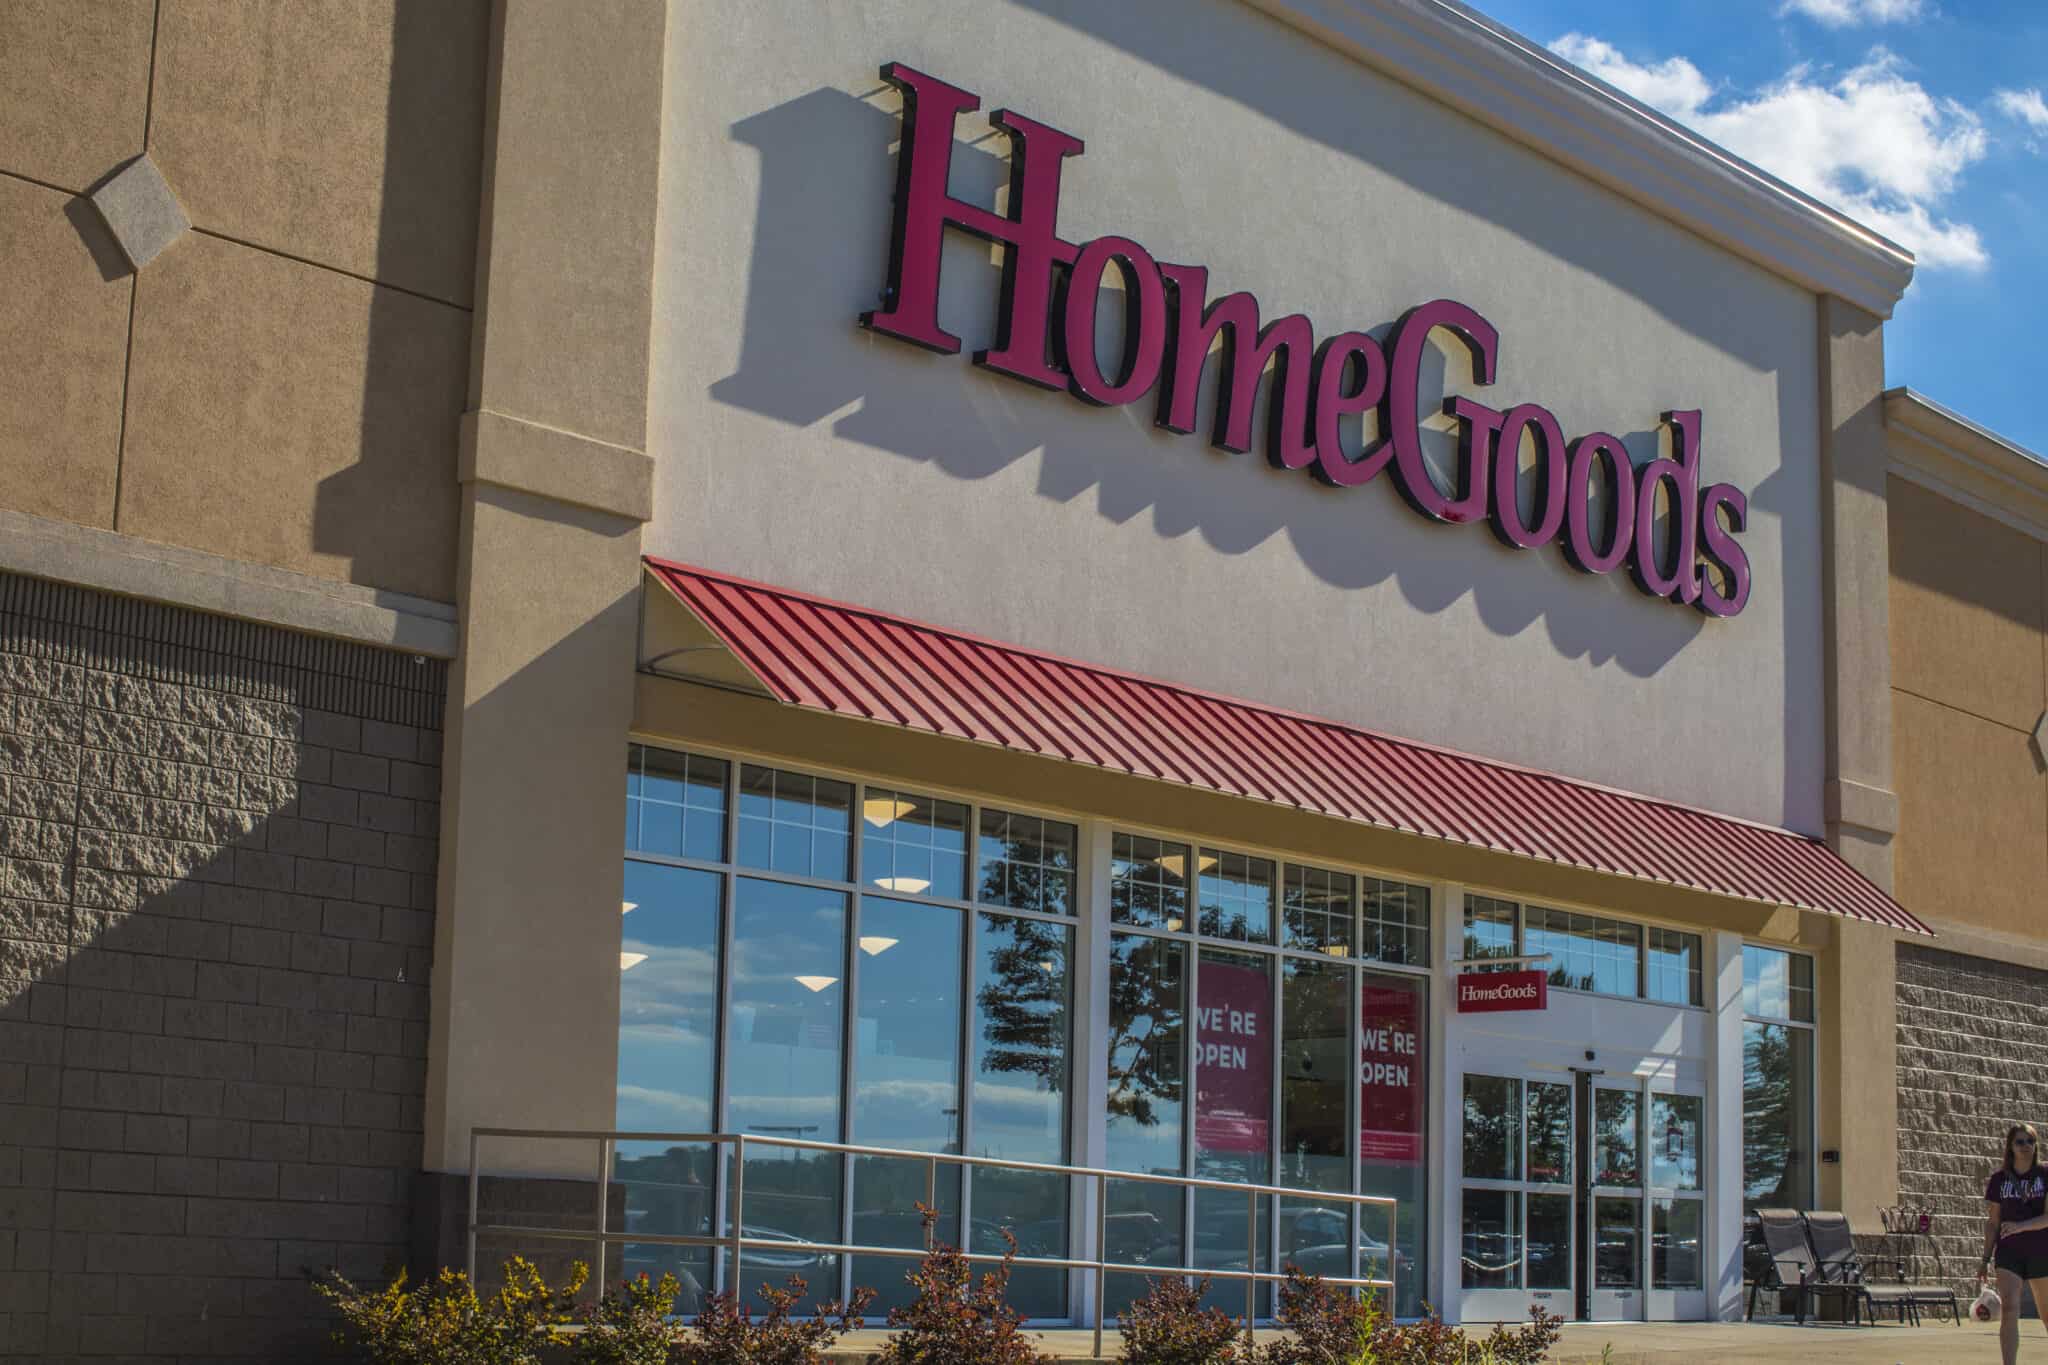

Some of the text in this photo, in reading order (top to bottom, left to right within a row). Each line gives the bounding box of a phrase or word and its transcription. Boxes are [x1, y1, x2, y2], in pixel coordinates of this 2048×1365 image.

[859, 62, 1751, 617] HomeGoods
[1462, 983, 1537, 1001] HomeGoods
[1360, 1024, 1416, 1055] WE'RE
[1360, 1062, 1408, 1088] OPEN
